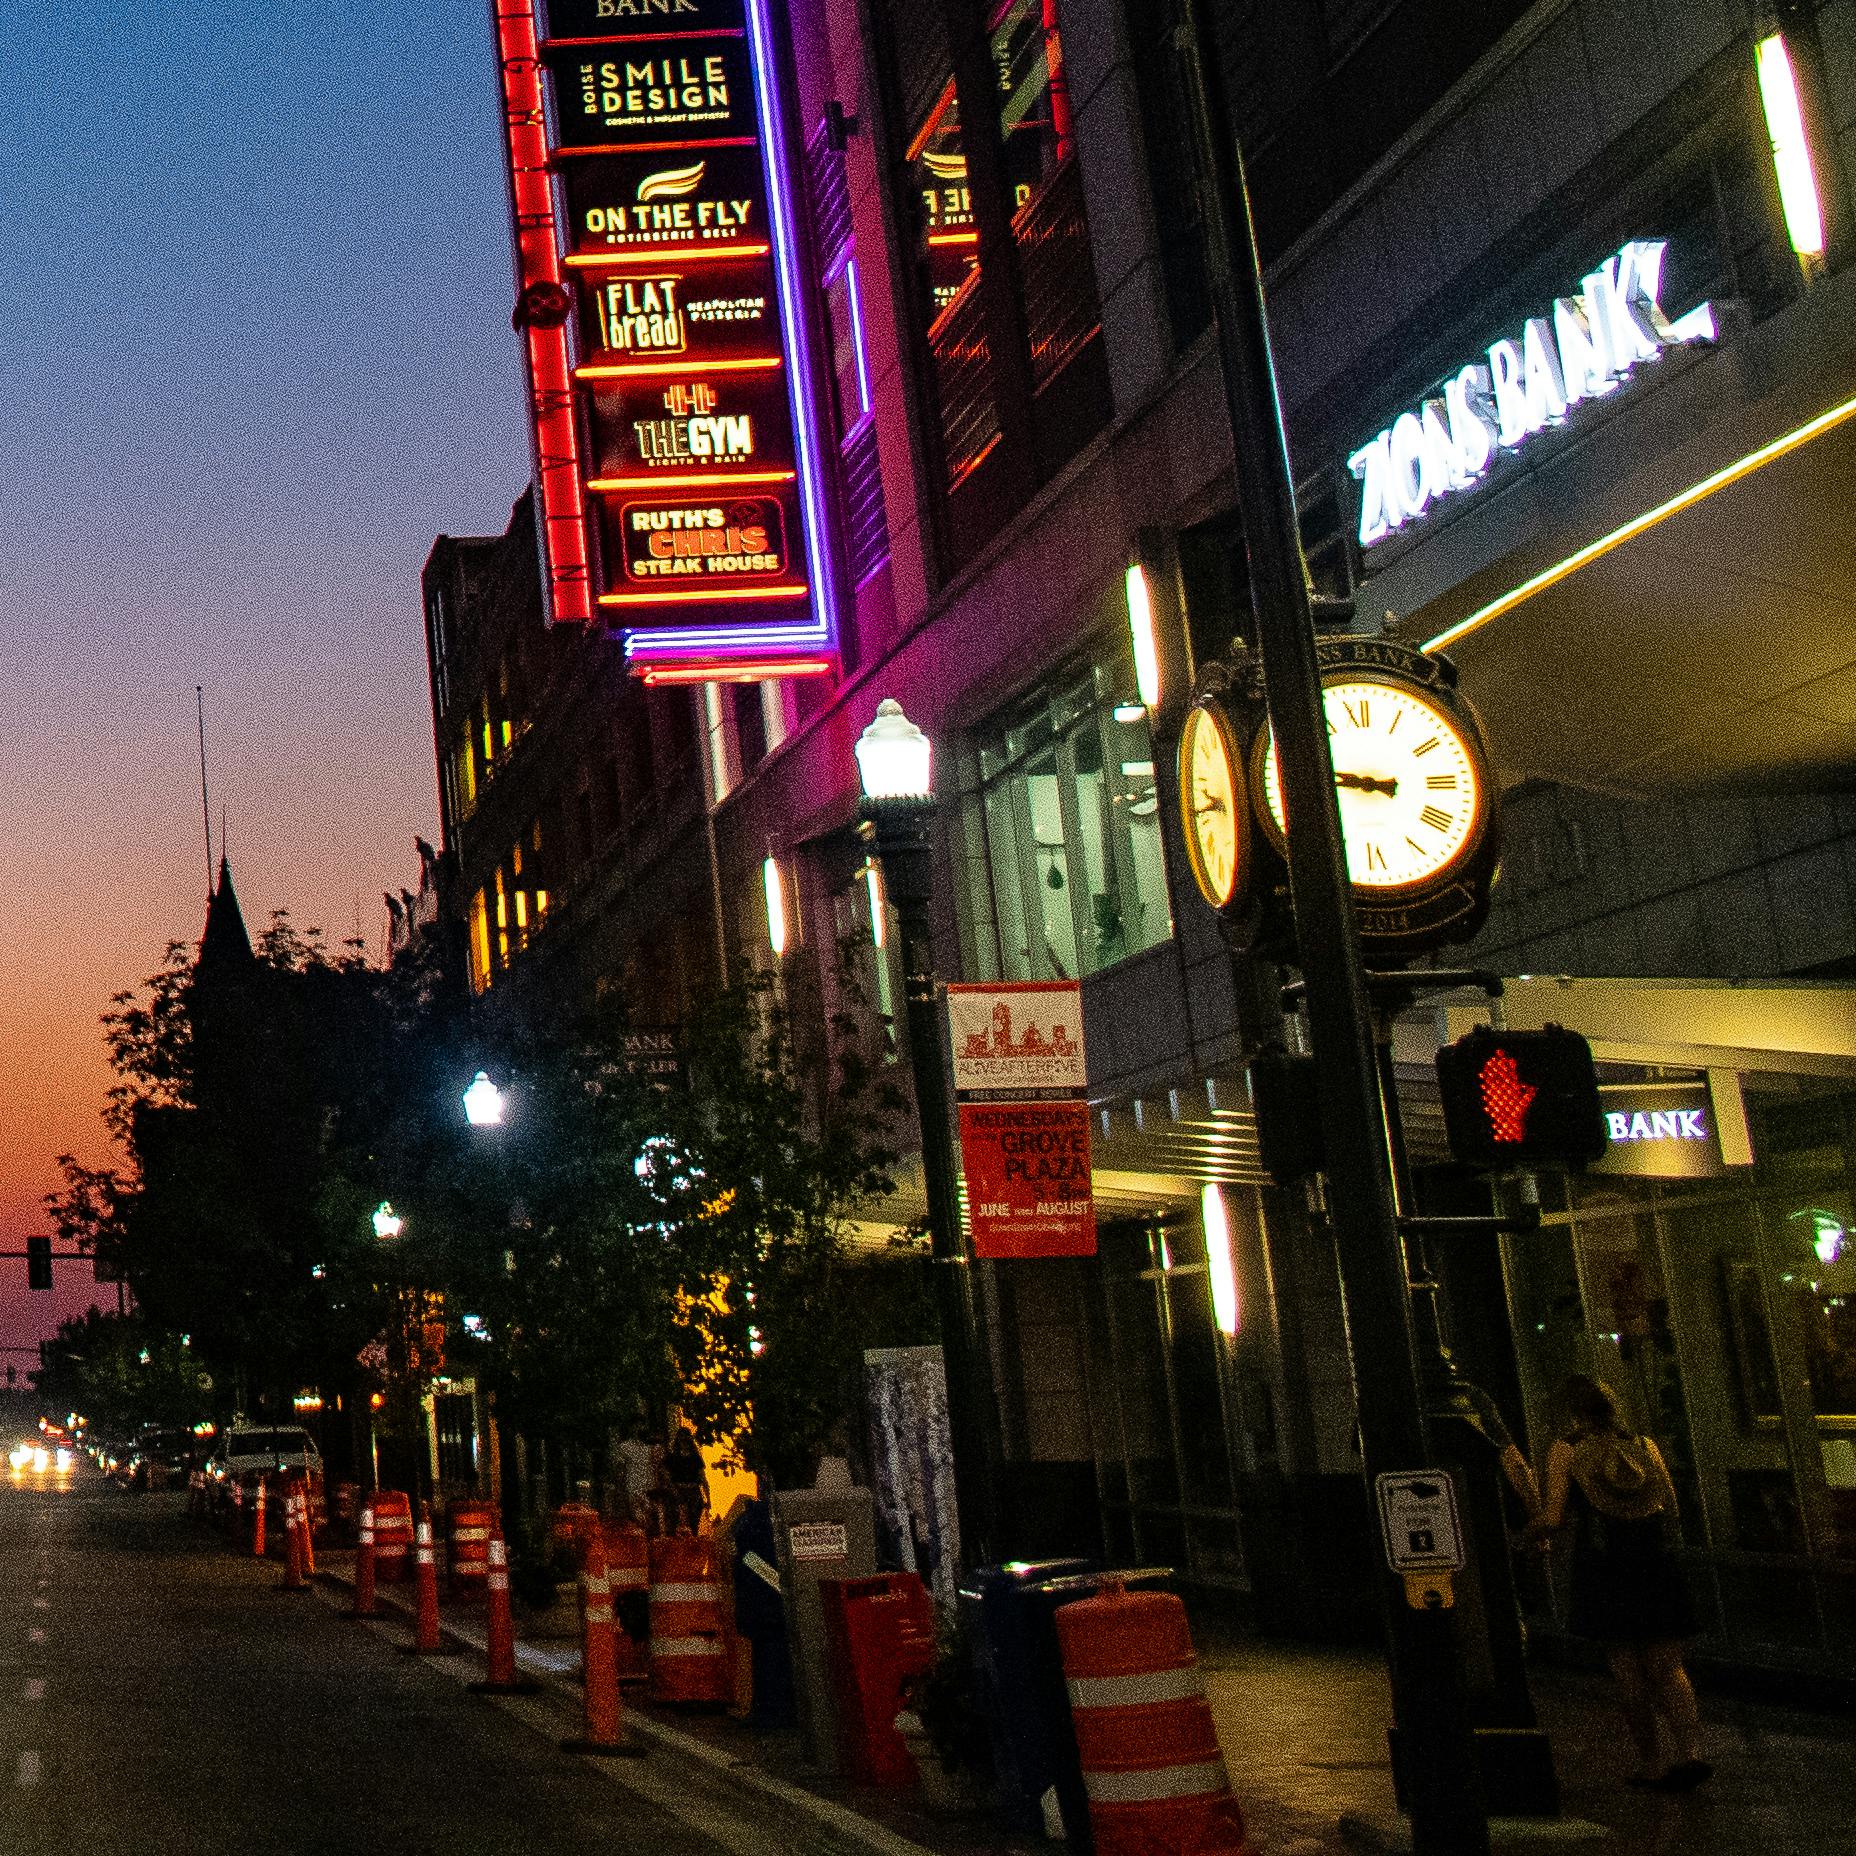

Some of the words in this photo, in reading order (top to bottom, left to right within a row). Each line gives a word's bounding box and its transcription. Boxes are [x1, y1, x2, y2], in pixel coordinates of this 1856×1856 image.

[600, 56, 726, 88] SMILE
[579, 64, 598, 114] BOISE
[602, 85, 730, 112] DESIGN
[585, 207, 627, 233] ON
[632, 203, 692, 230] THE
[696, 199, 752, 227] FLY
[607, 280, 677, 316] FLAT
[609, 312, 679, 349] bread
[1347, 364, 1500, 548] ZIONS
[1484, 239, 1719, 452] BANK
[714, 454, 747, 465] MAIN
[631, 507, 727, 531] RUTH'S
[648, 526, 770, 559] CHRIS
[633, 557, 703, 577] STEAK
[707, 553, 780, 573] HOUSE
[1353, 644, 1415, 673] BANK
[971, 1109, 1086, 1128] WEDNESDAYS
[1604, 1110, 1707, 1142] BANK
[1000, 1130, 1086, 1155] GROVE
[1005, 1155, 1086, 1182] PLAZA
[978, 1202, 1010, 1217] JUNE
[1036, 1200, 1088, 1216] AUGUST
